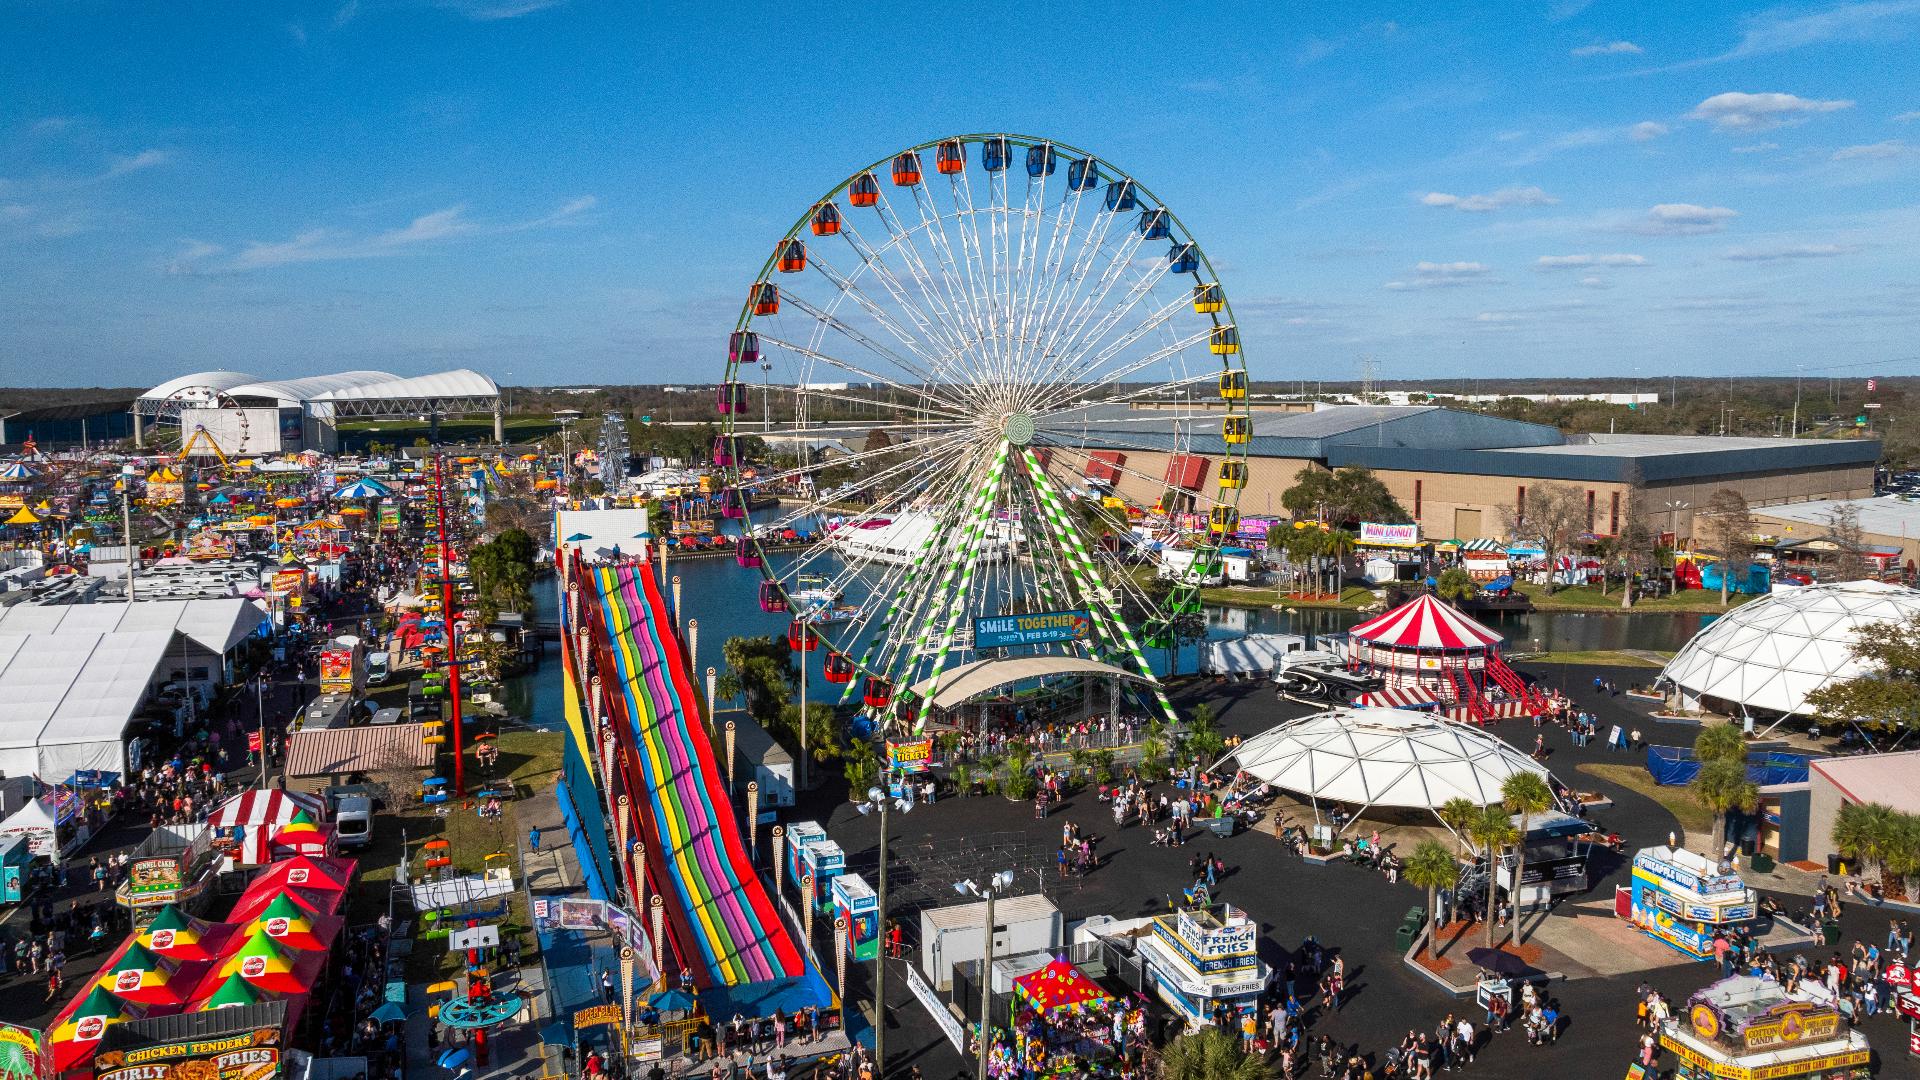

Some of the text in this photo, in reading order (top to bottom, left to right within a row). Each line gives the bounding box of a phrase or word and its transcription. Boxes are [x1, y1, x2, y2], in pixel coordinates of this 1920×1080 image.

[1366, 525, 1384, 536] MINI
[1018, 615, 1076, 630] TOGETHER
[897, 750, 929, 762] TICKETS
[135, 860, 176, 870] FUNNEL CAKES
[1182, 928, 1200, 951] FRIES
[1203, 932, 1254, 945] FRENCH
[1208, 942, 1249, 954] FRIES
[1204, 960, 1233, 970] FRENCH
[1235, 956, 1255, 968] FRIES
[1216, 985, 1241, 994] FRENCH
[1748, 1028, 1777, 1038] COTTON
[1809, 1026, 1831, 1037] APPLES
[1750, 1037, 1774, 1046] CANDY
[127, 1036, 251, 1063] CHICKEN TENDERS
[1663, 1038, 1710, 1068] COTTON CANDY
[217, 1050, 272, 1069] FRIES
[1753, 1069, 1769, 1079] CANDY
[1771, 1066, 1788, 1076] APPLES
[1793, 1063, 1811, 1073] COTTON
[1812, 1060, 1828, 1069] CANDY
[1852, 1054, 1867, 1063] APPLES
[103, 1066, 168, 1080] CURLY
[225, 1070, 242, 1078] HOT
